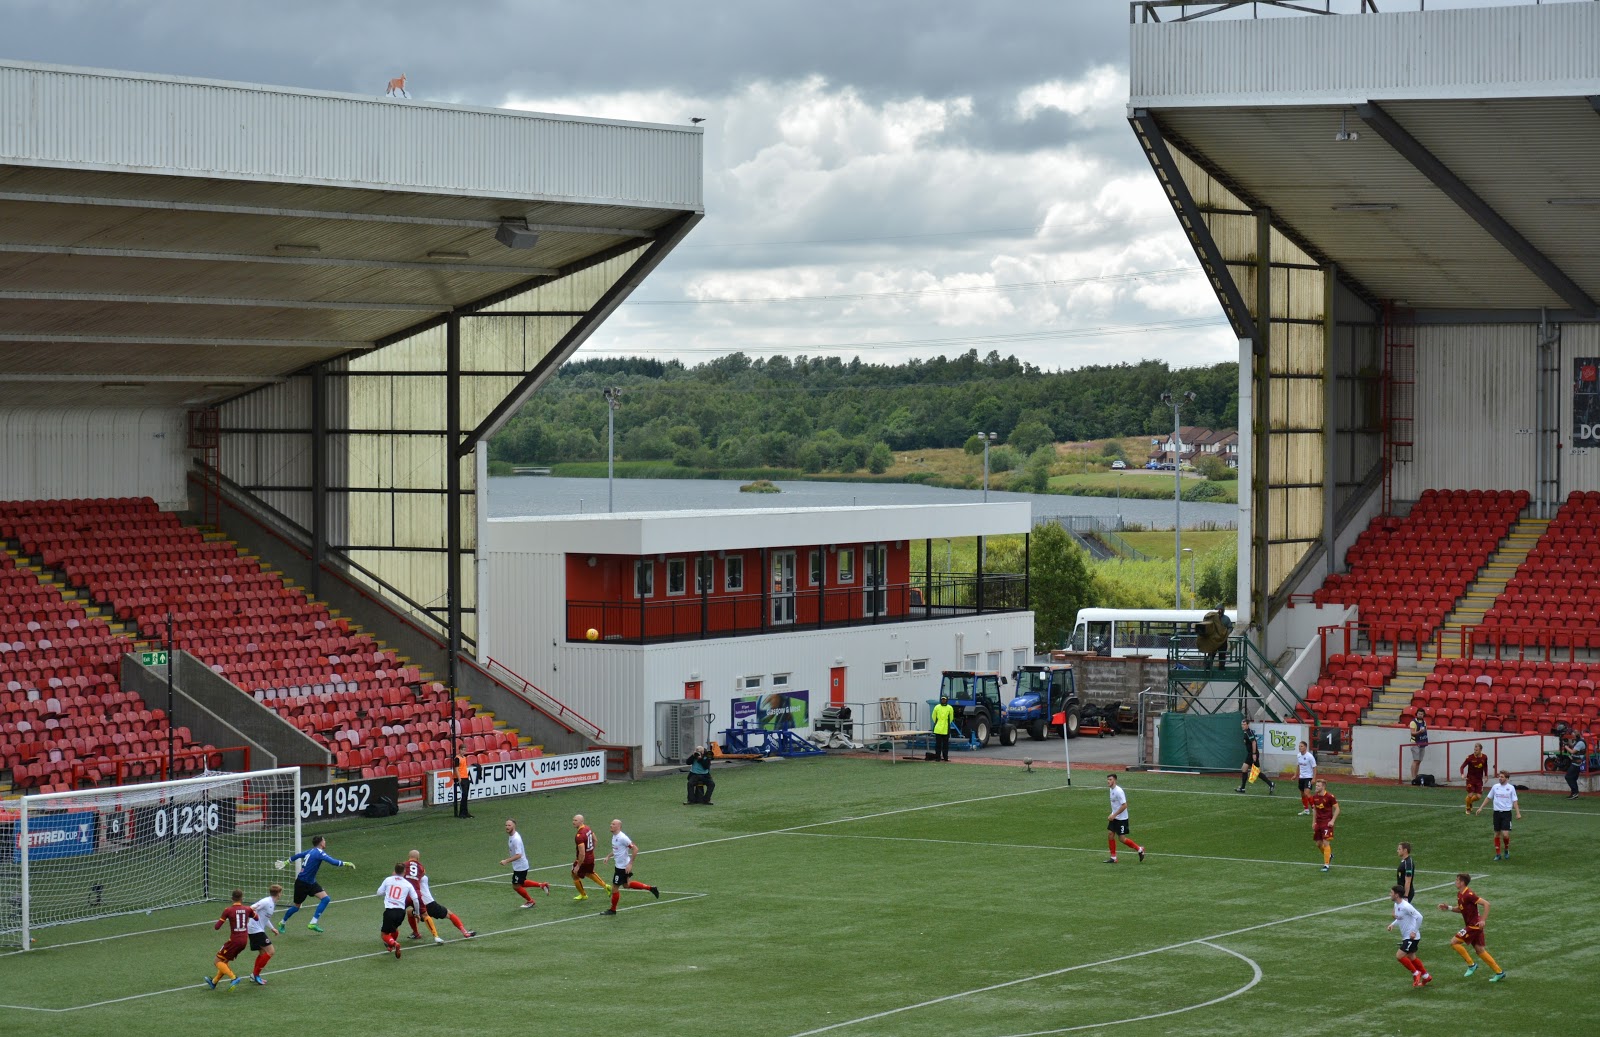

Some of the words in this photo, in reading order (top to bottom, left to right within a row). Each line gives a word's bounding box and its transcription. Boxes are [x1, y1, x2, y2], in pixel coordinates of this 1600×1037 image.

[1269, 730, 1297, 748] biz
[1326, 733, 1332, 745] 1
[540, 760, 560, 773] 0141
[563, 758, 578, 771] 959
[580, 755, 601, 768] 0066
[437, 761, 526, 789] PATFORM
[300, 783, 371, 819] 341952
[112, 819, 119, 834] 6
[154, 803, 219, 837] 01236
[65, 831, 78, 841] CUP
[409, 864, 418, 877] 9
[389, 884, 402, 900] 10
[235, 913, 246, 930] 11
